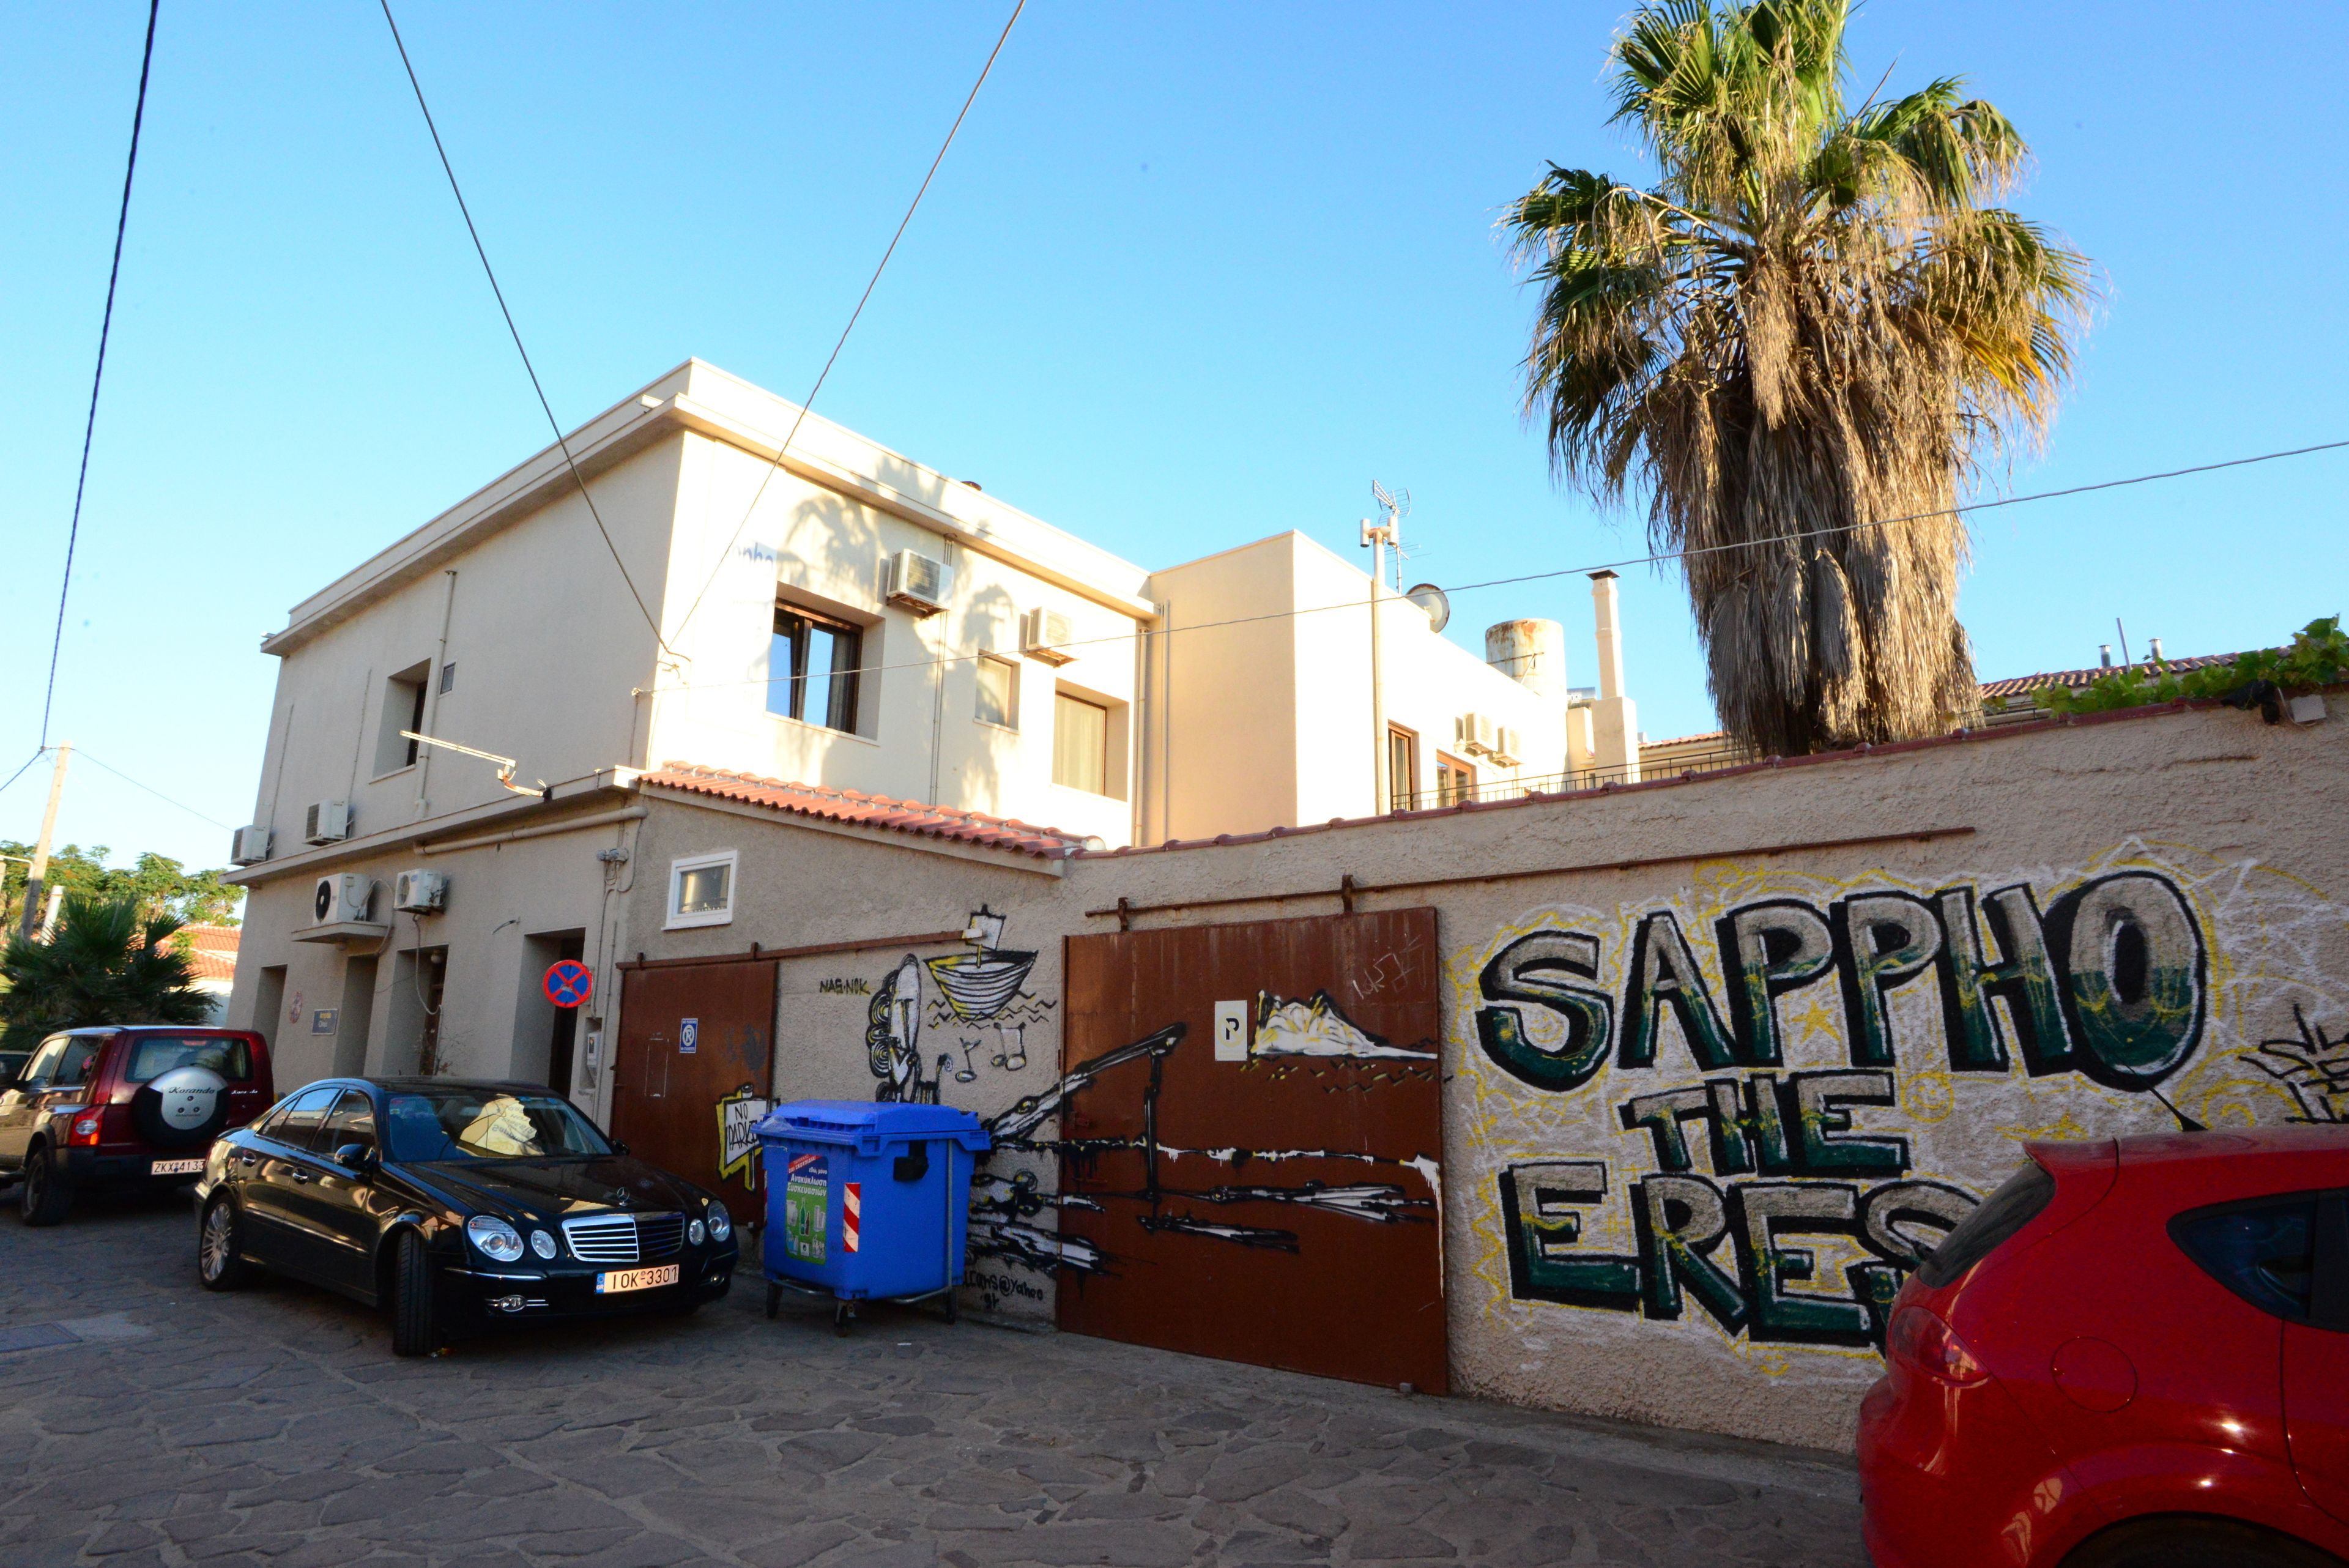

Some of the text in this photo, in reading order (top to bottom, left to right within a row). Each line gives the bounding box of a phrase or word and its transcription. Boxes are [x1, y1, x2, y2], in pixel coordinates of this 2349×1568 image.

[1475, 871, 2205, 1092] SAPPHO
[735, 1102, 748, 1120] NO
[1619, 1068, 1910, 1178] THE
[791, 1173, 827, 1186] Ανακύκλωση
[787, 1183, 826, 1196] Συσκευασιών
